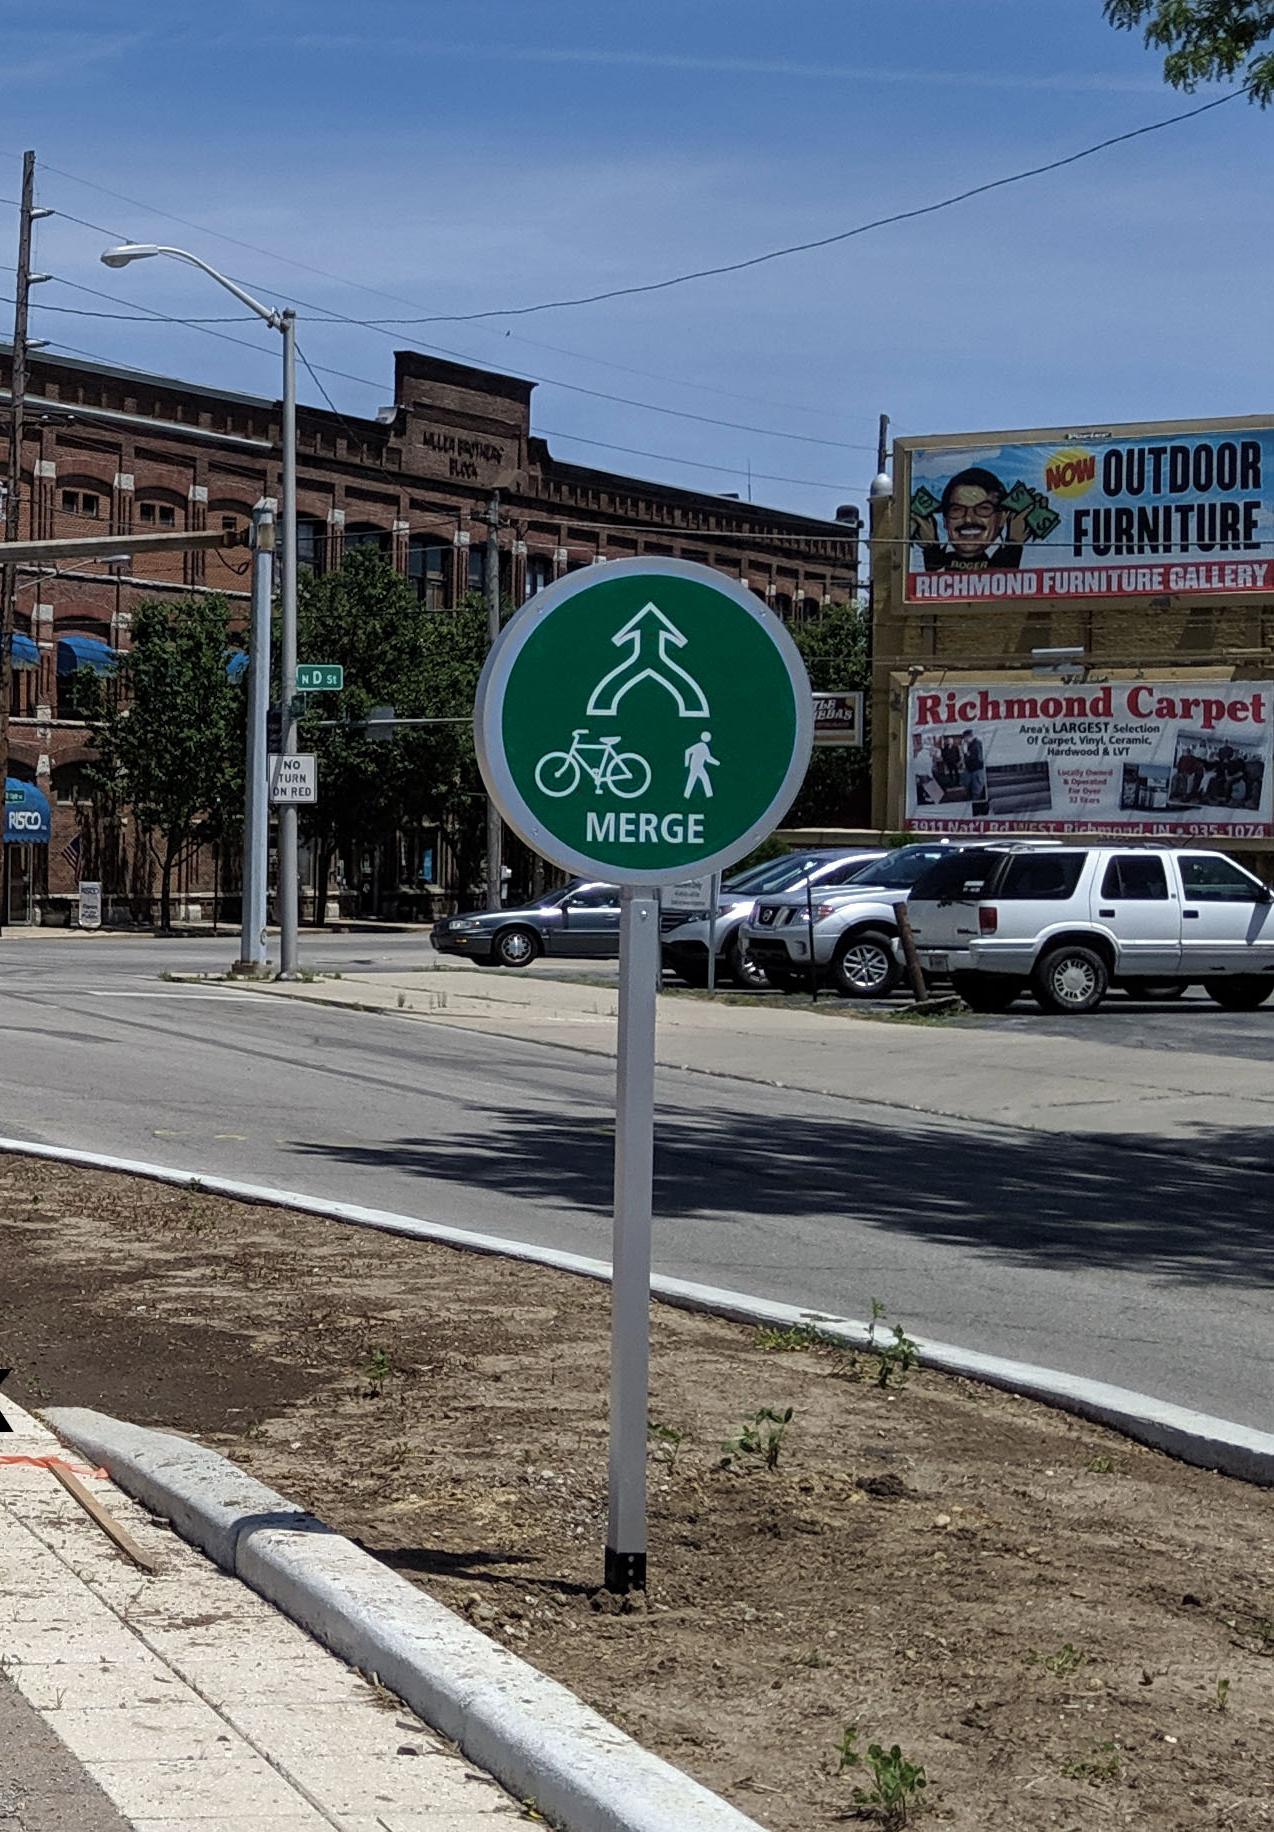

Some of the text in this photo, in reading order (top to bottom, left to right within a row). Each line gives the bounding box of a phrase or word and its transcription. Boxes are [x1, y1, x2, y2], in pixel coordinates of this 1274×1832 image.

[1045, 455, 1096, 492] NOW
[1102, 440, 1262, 498] OUTDOOR
[1073, 500, 1262, 557] FURNITURE
[915, 563, 1268, 598] RICHMOND FURNITURE GALLERY
[302, 671, 337, 684] N D St
[915, 687, 1266, 729] Richmond Carpet
[1019, 722, 1160, 734] Area's LARGEST Selection
[1027, 735, 1152, 747] Of Carpet, Vinyl, Ceramic,
[1047, 747, 1130, 756] Hardwood & LVT
[284, 761, 300, 770] NO
[279, 774, 306, 783] TURN
[273, 787, 311, 797] ON RED
[9, 811, 42, 829] RISCO
[585, 812, 705, 844] MERGE
[989, 821, 1009, 833] Rd
[1153, 824, 1170, 835] IN
[1190, 824, 1265, 837] 935-1074
